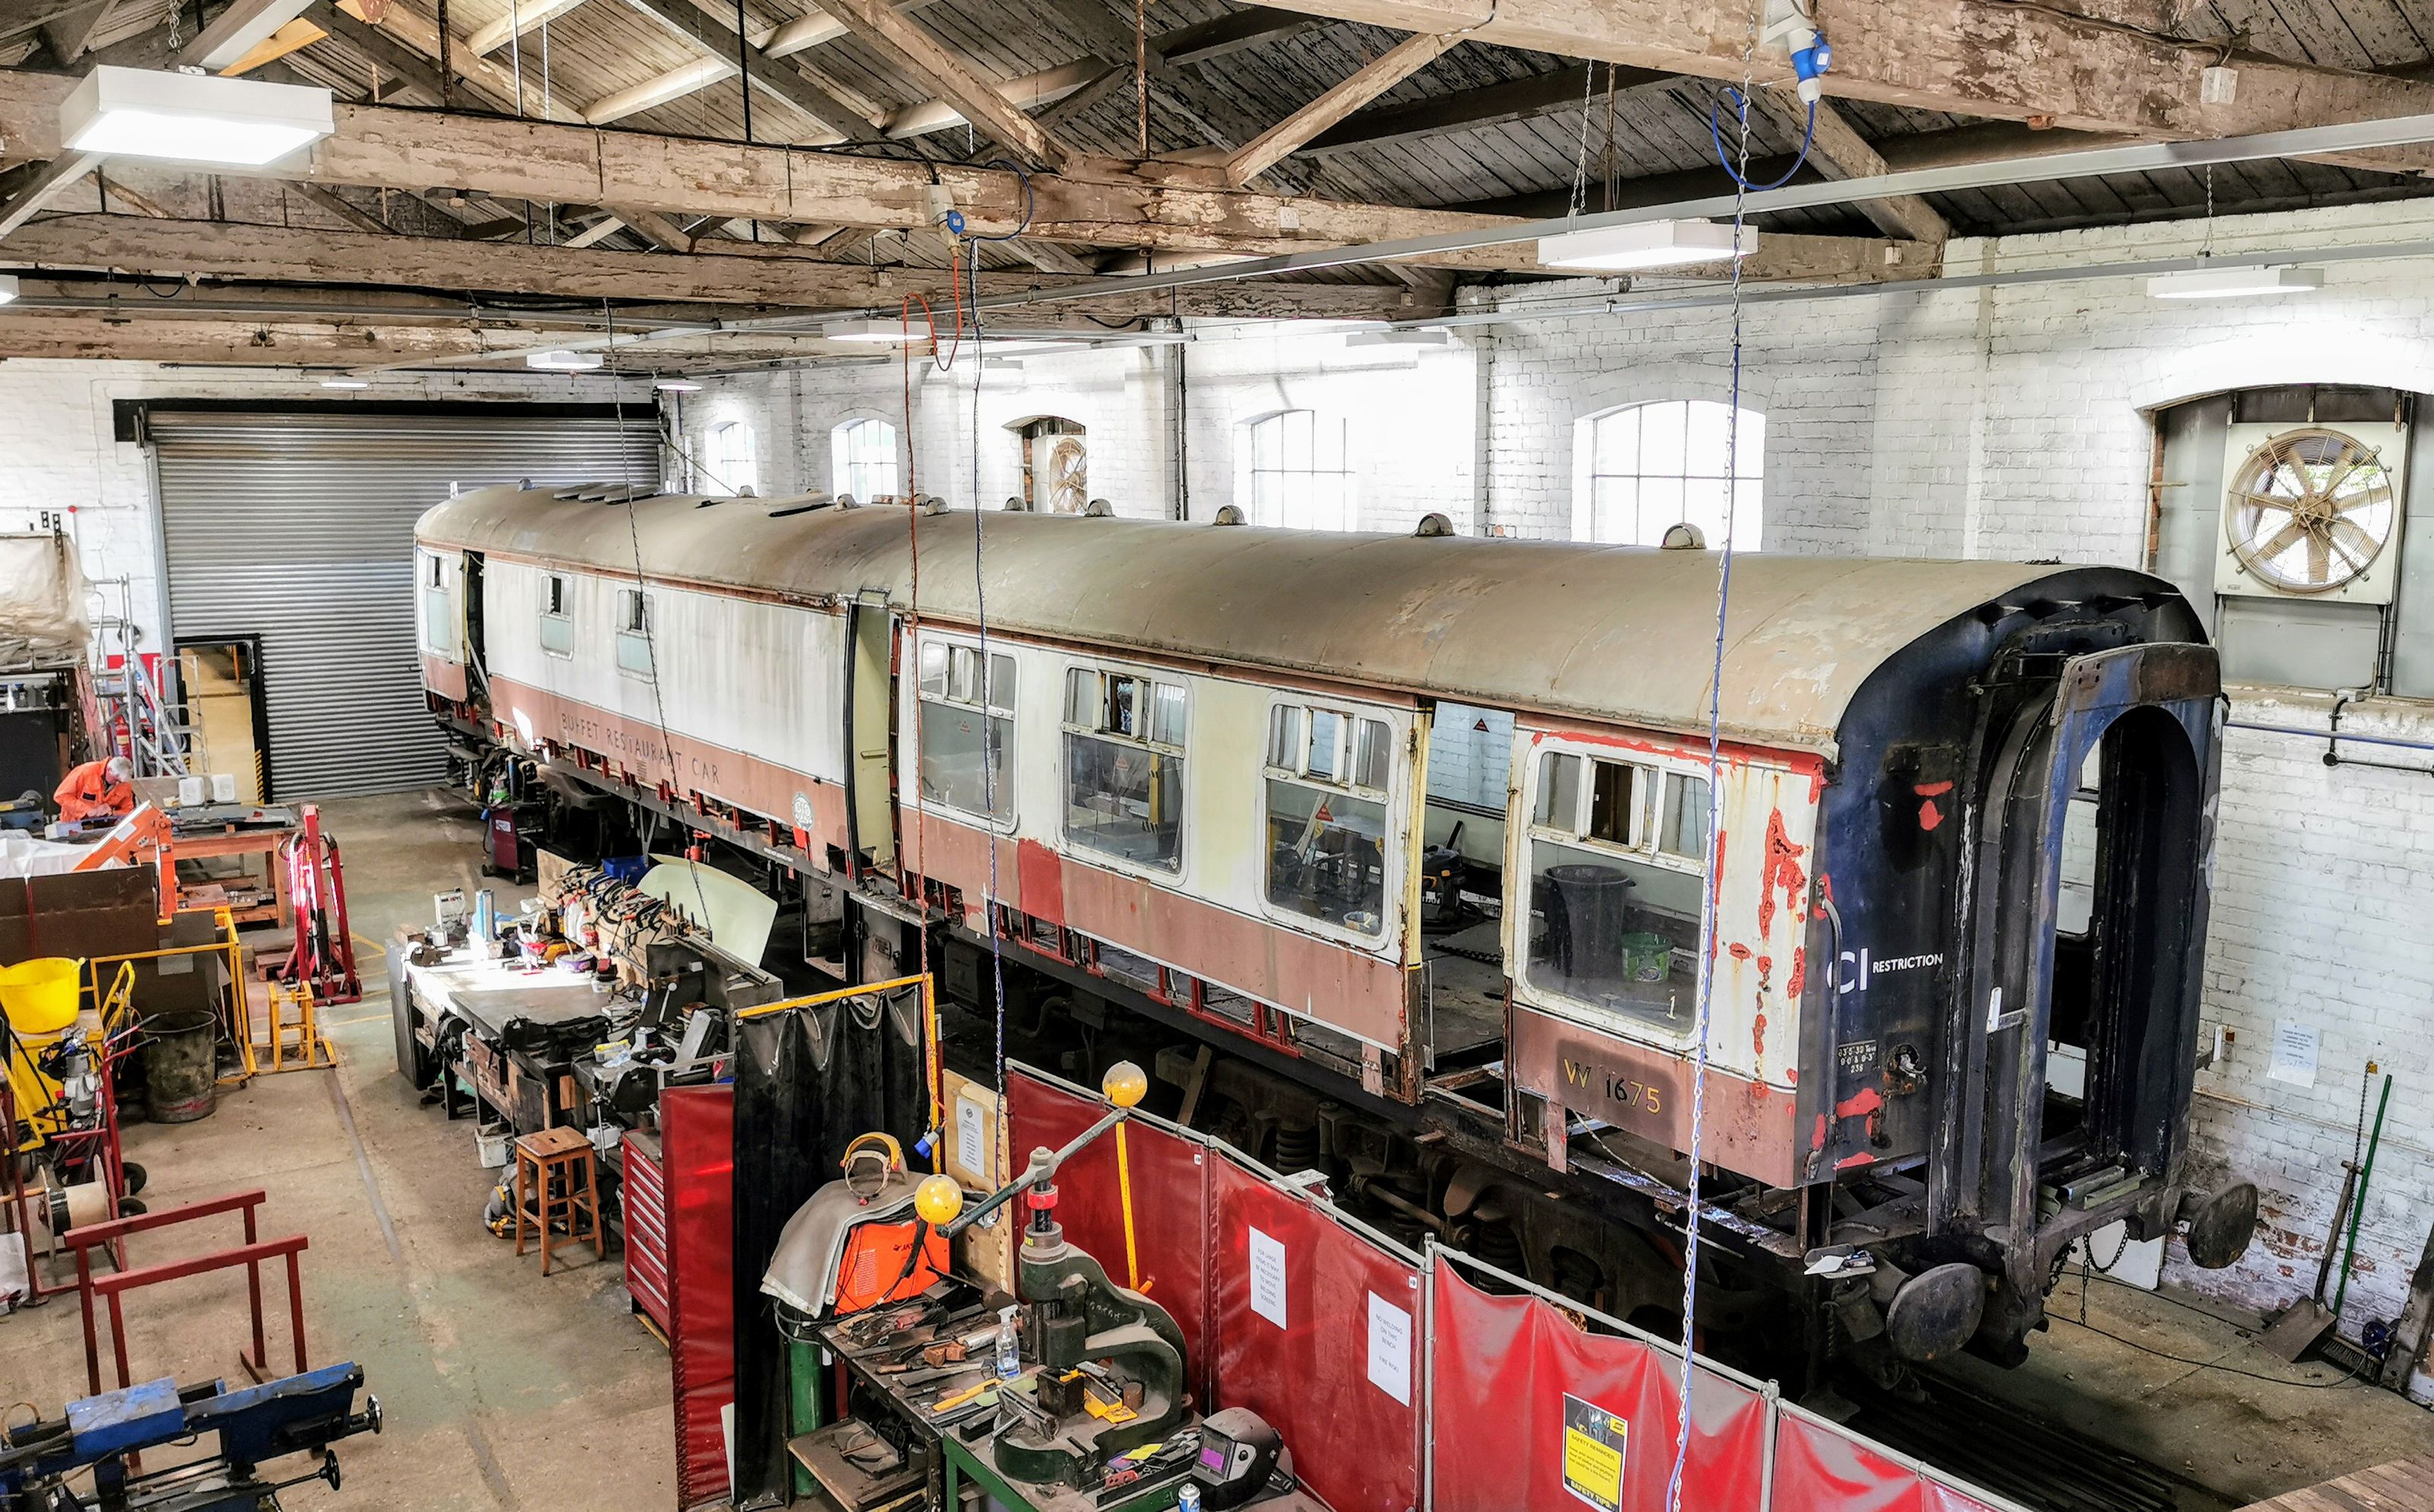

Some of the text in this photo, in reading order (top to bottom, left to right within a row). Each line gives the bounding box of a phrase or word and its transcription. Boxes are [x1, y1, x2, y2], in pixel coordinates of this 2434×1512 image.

[561, 713, 598, 740] BUFFET
[605, 728, 682, 770] RESTAURANT
[691, 758, 720, 785] CAR
[1363, 912, 1371, 929] 2
[1873, 953, 1943, 974] RESTRICTION
[1666, 995, 1676, 1020] 1
[1563, 1058, 1661, 1115] W 1675
